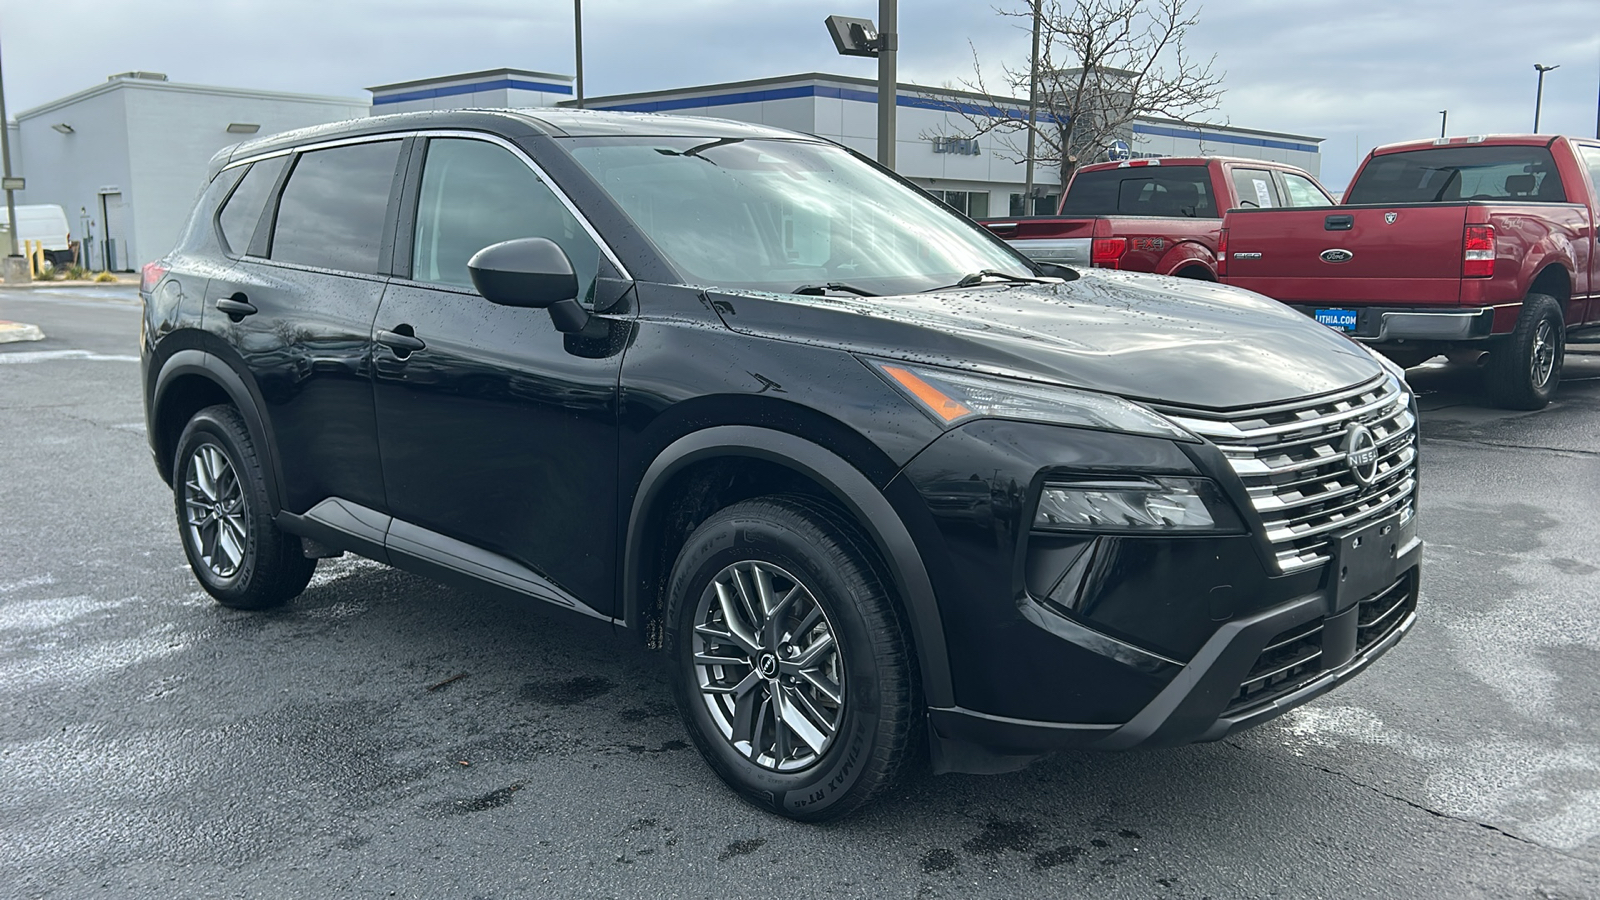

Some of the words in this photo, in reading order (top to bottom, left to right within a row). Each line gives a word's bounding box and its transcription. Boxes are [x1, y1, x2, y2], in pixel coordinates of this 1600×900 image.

[933, 137, 981, 155] LITHIA
[1132, 238, 1164, 250] FX4
[1326, 251, 1345, 260] Ford
[827, 719, 866, 793] ALTIMAX
